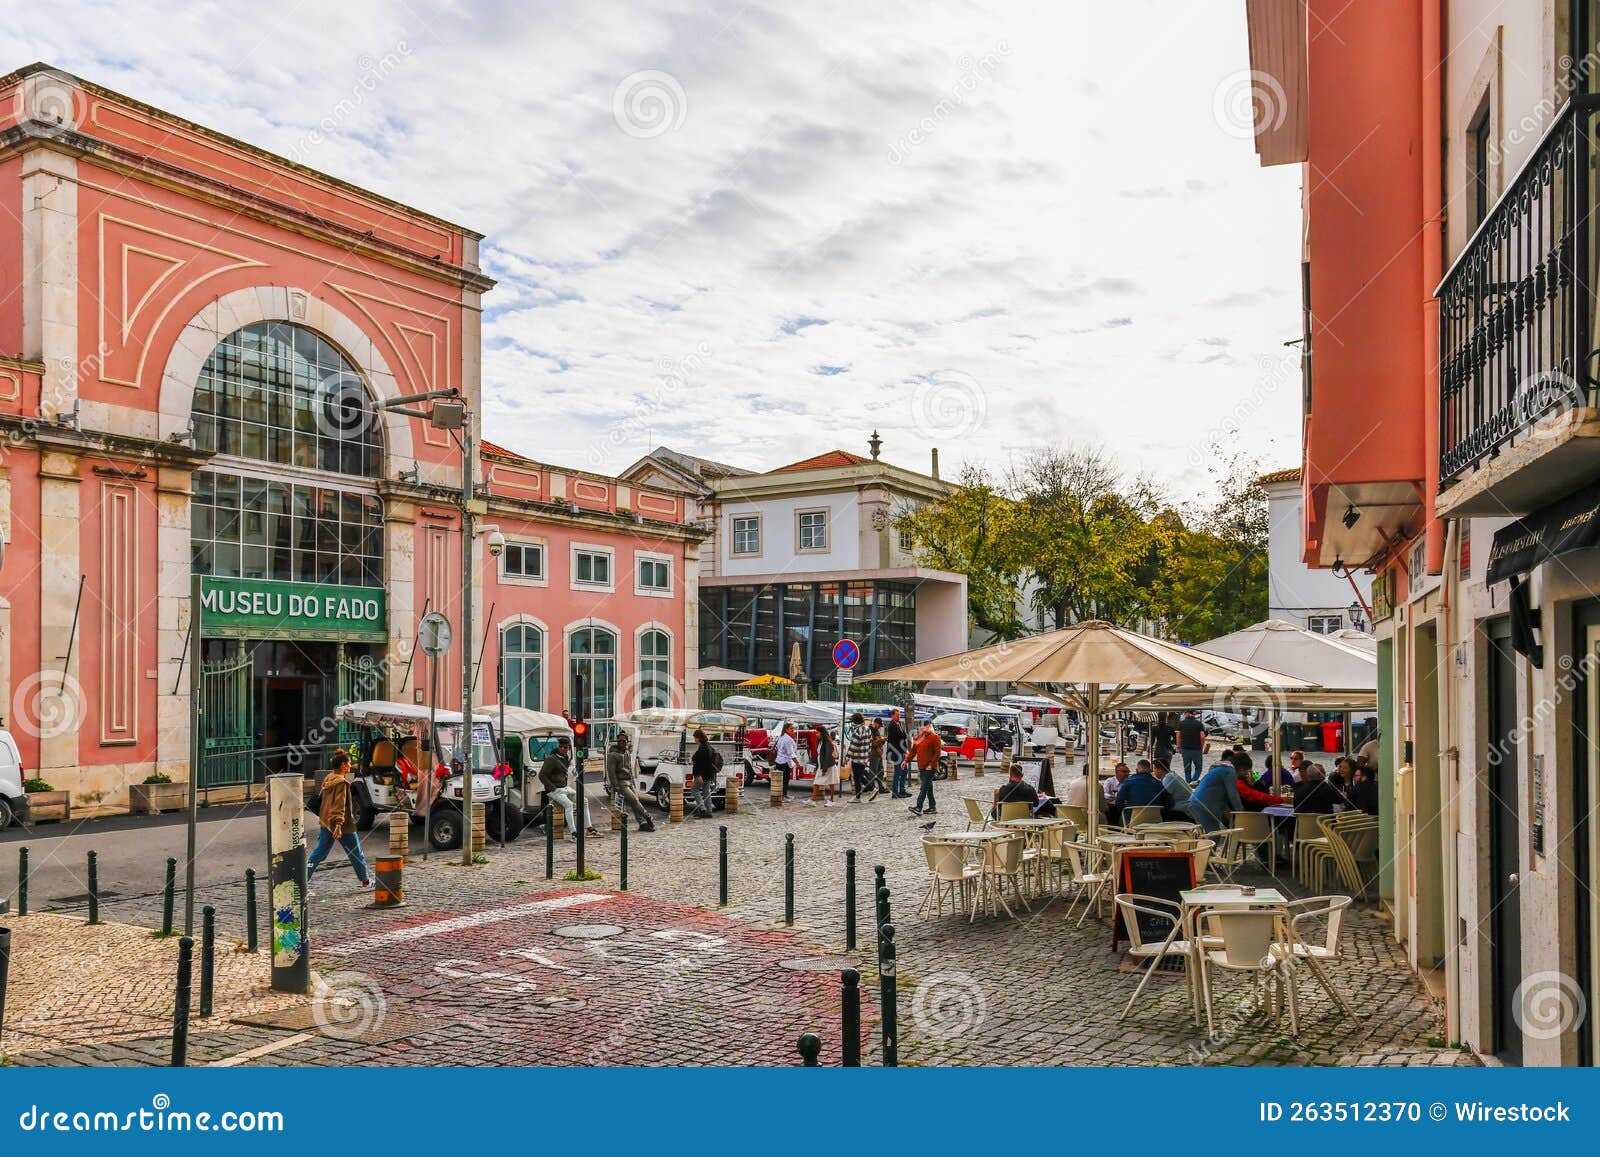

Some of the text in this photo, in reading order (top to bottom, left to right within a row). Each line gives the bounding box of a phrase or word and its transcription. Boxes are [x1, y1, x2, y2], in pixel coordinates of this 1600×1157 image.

[200, 589, 379, 620] MUSEU DO FADO
